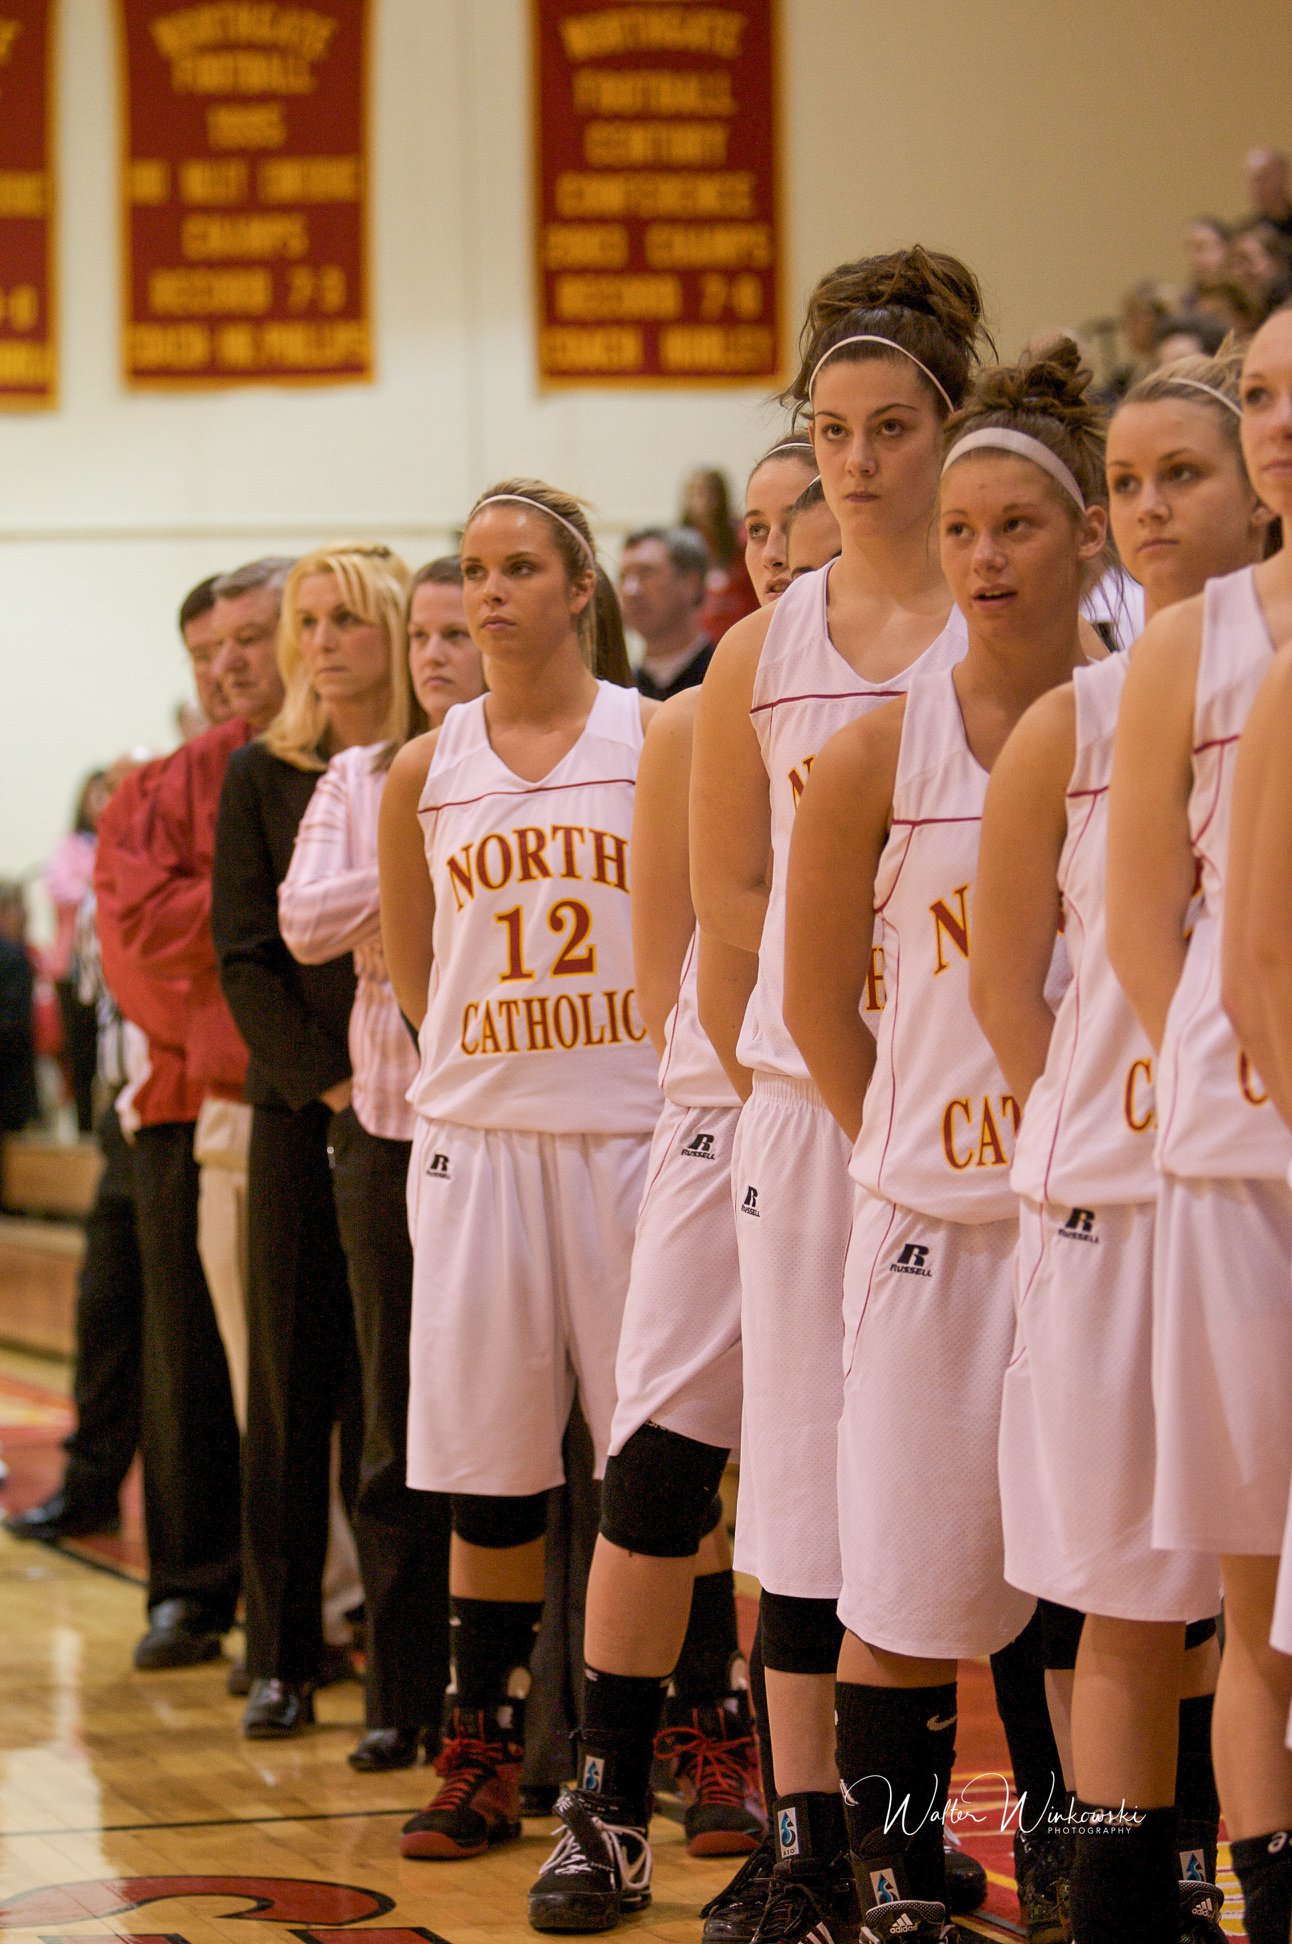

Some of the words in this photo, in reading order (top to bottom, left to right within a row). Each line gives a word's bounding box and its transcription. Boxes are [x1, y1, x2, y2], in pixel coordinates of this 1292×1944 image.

[446, 824, 631, 912] NORTH
[494, 897, 597, 984] 12
[460, 988, 647, 1056] CATHOLIC
[681, 1149, 716, 1160] RUSSELL
[1058, 1228, 1100, 1244] RUSSELL
[889, 1264, 932, 1278] RUSSELL
